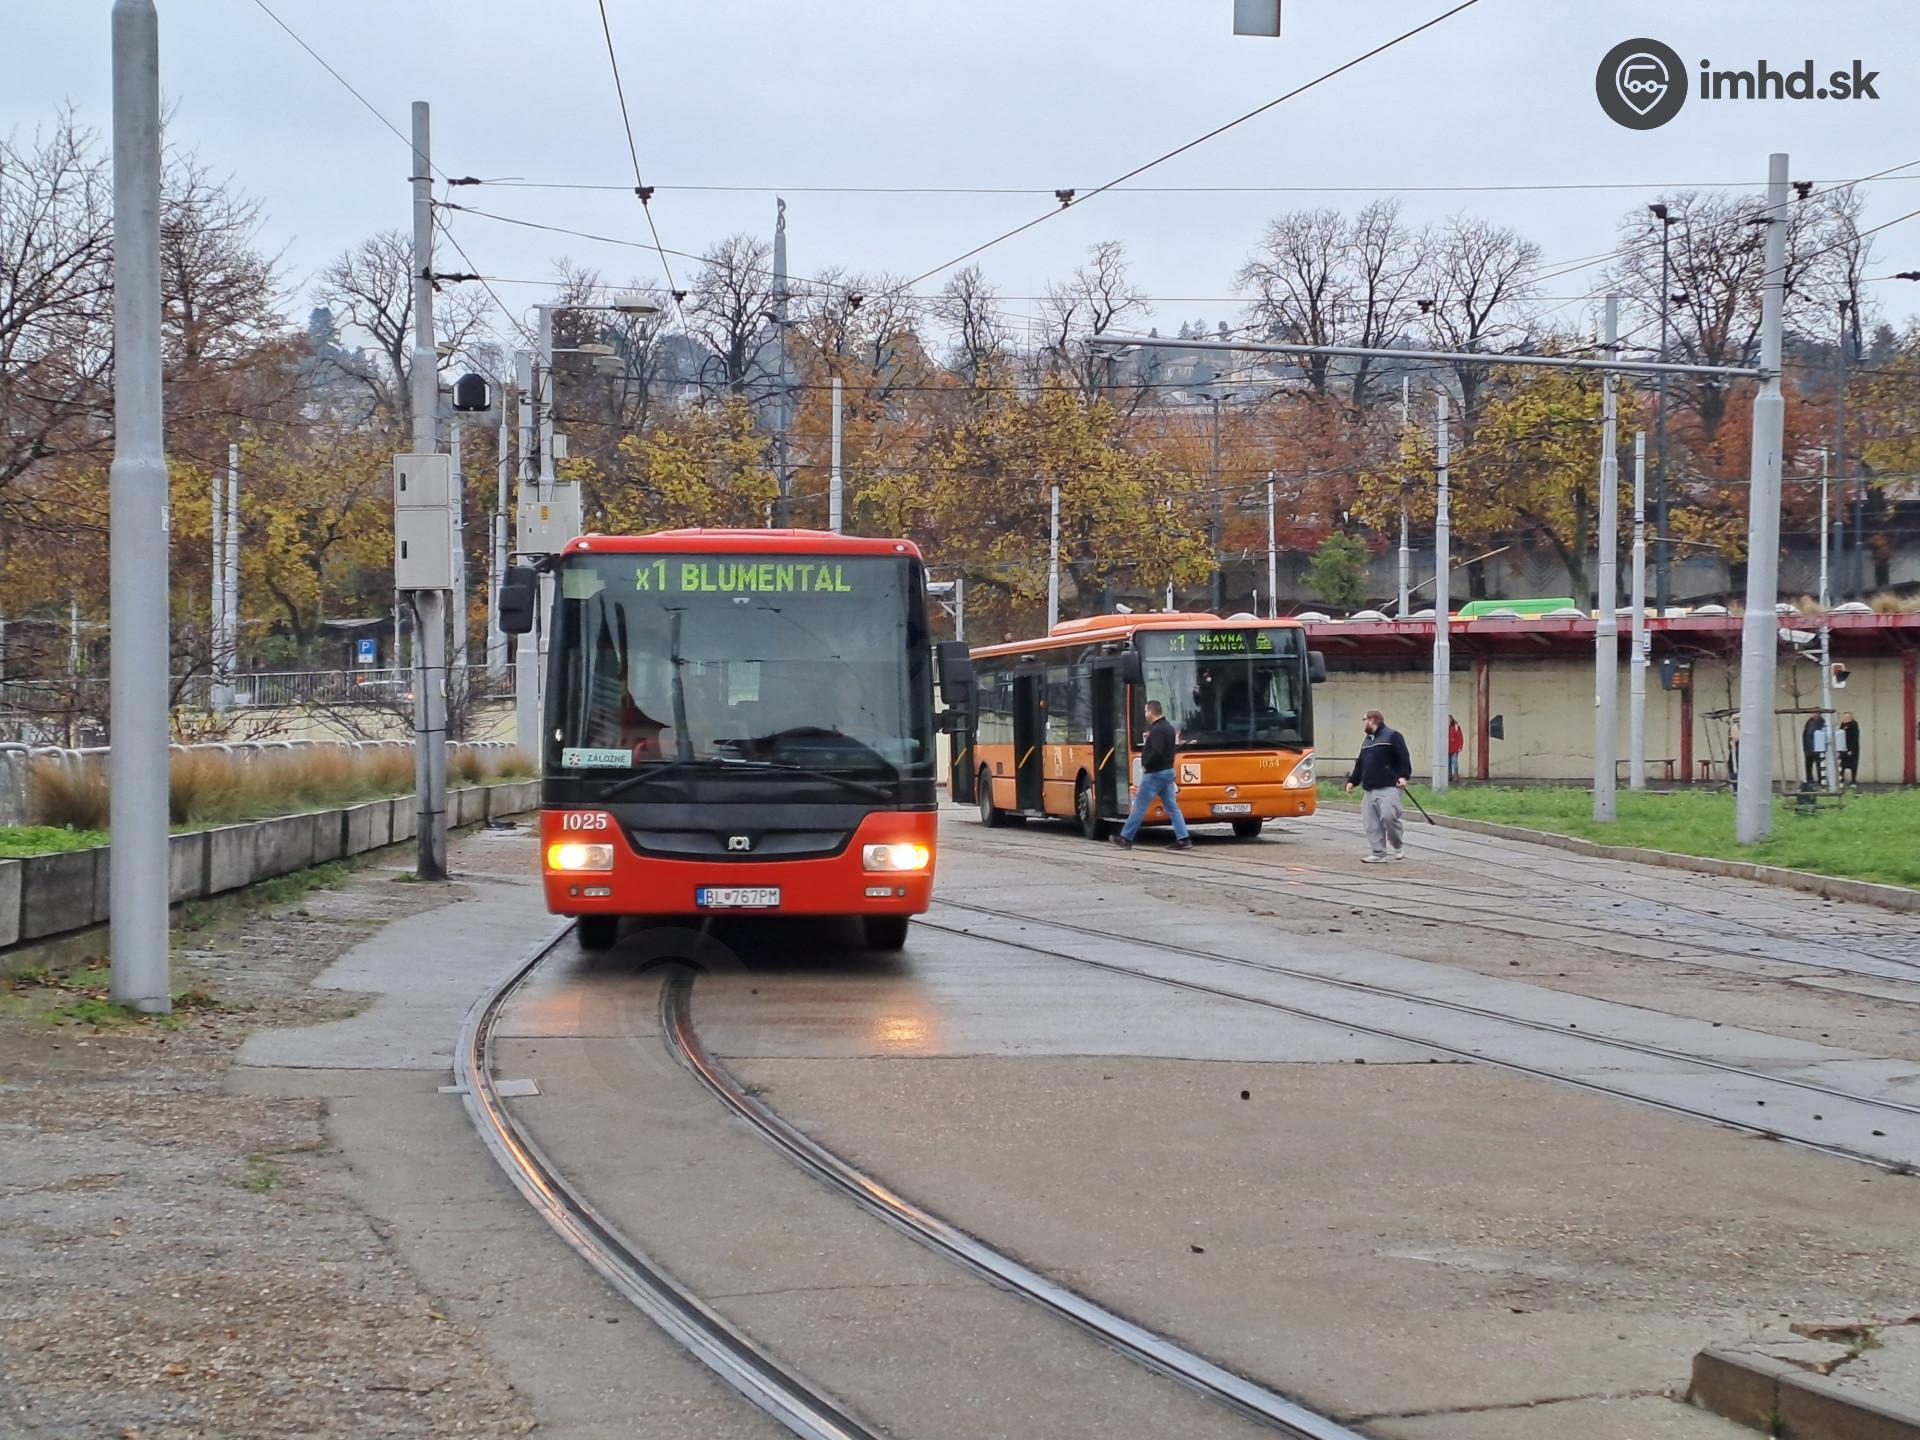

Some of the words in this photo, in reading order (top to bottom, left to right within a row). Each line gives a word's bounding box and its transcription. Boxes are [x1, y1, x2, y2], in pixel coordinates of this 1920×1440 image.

[636, 559, 665, 591] x1
[361, 641, 370, 653] P
[563, 813, 607, 830] 1025
